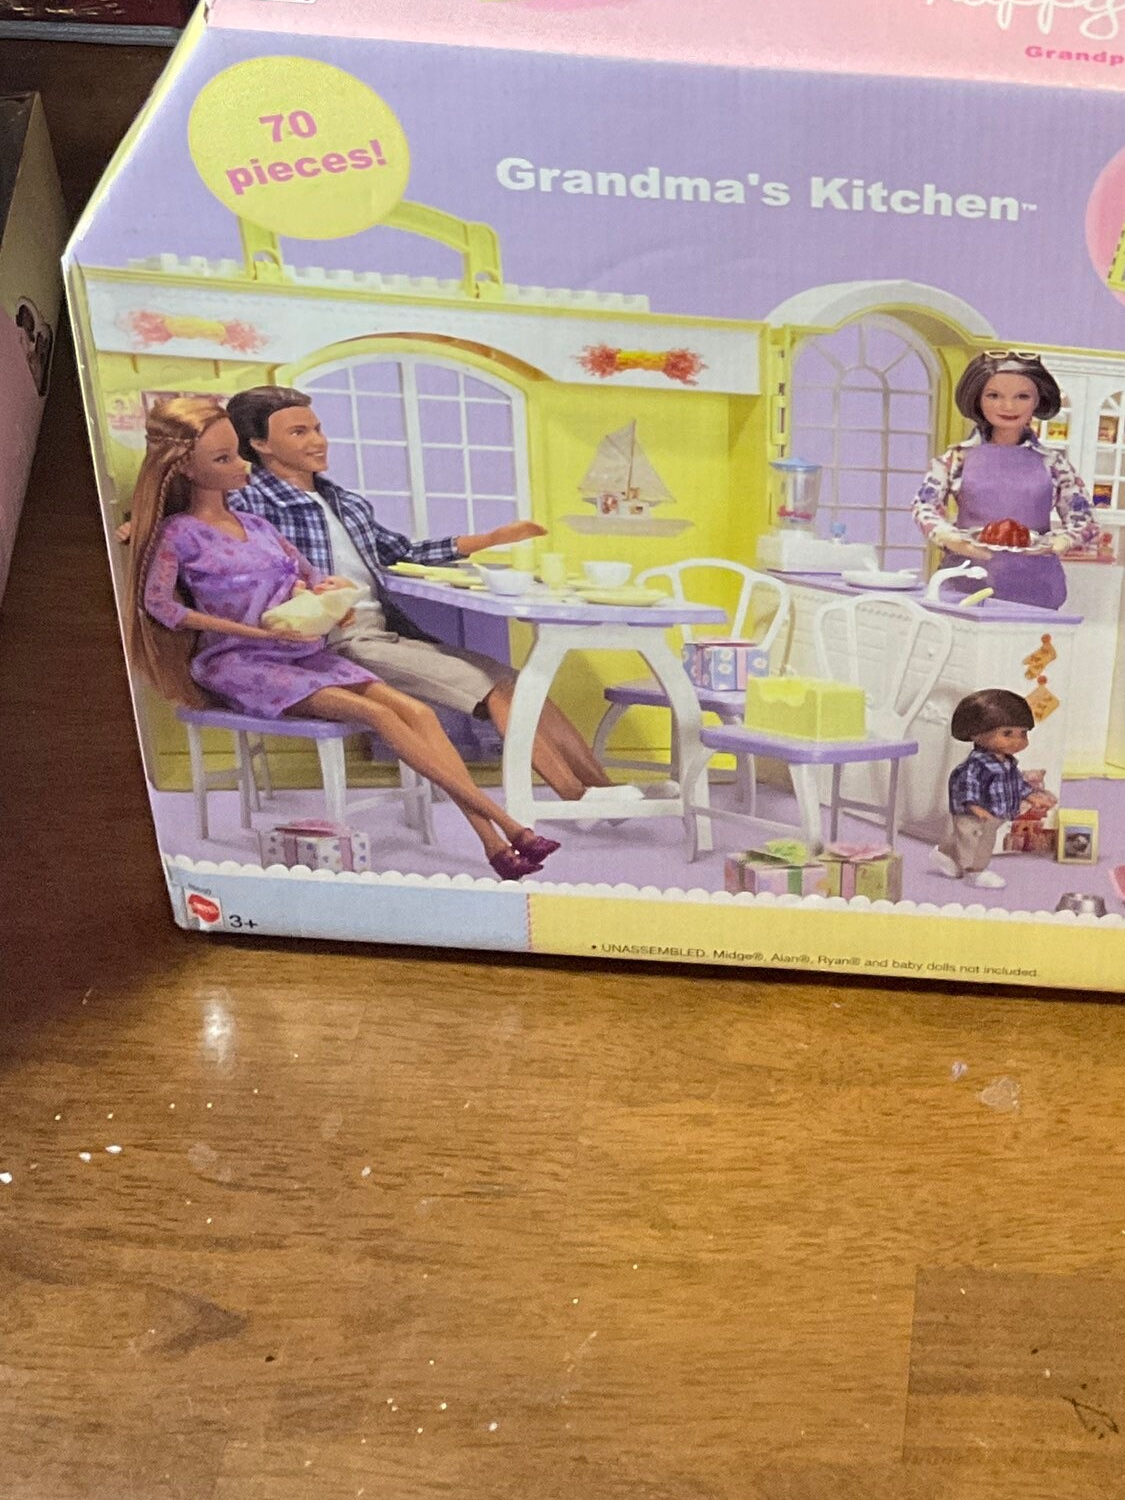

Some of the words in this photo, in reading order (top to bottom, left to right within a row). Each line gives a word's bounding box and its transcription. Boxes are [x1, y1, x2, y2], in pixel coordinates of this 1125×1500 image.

[258, 110, 318, 143] 70
[226, 139, 387, 195] pieces!
[496, 156, 791, 207] Grandma's
[229, 915, 258, 929] 3+
[864, 959, 888, 968] and
[892, 959, 923, 971] baby
[926, 962, 956, 973] dolls
[959, 965, 980, 974] not
